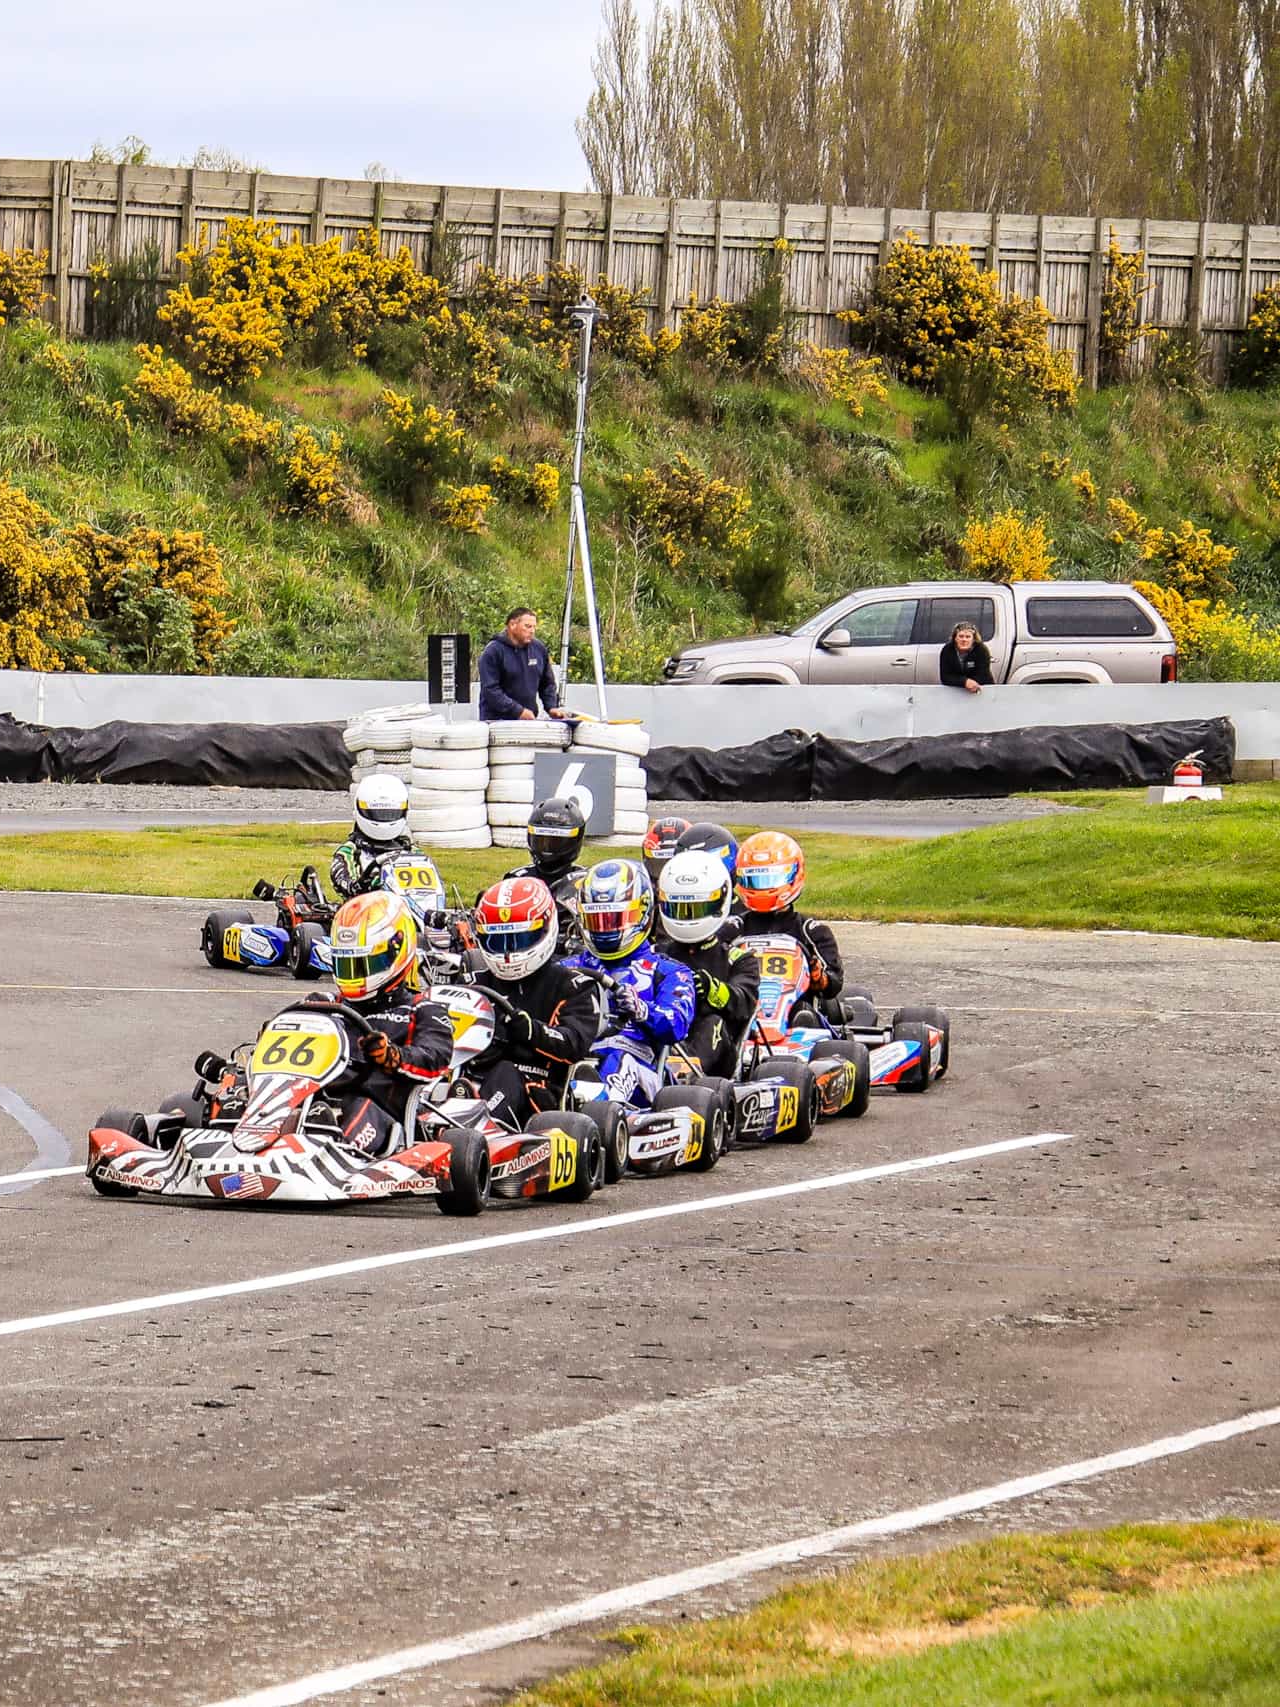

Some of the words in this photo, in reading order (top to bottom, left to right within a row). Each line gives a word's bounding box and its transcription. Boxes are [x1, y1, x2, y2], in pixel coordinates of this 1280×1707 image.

[553, 762, 594, 823] 6
[398, 870, 432, 887] 90
[225, 930, 238, 957] 90
[262, 1036, 317, 1067] 66
[780, 1090, 797, 1128] 23
[554, 1137, 573, 1184] 66
[361, 1179, 435, 1192] ALUMINOS
